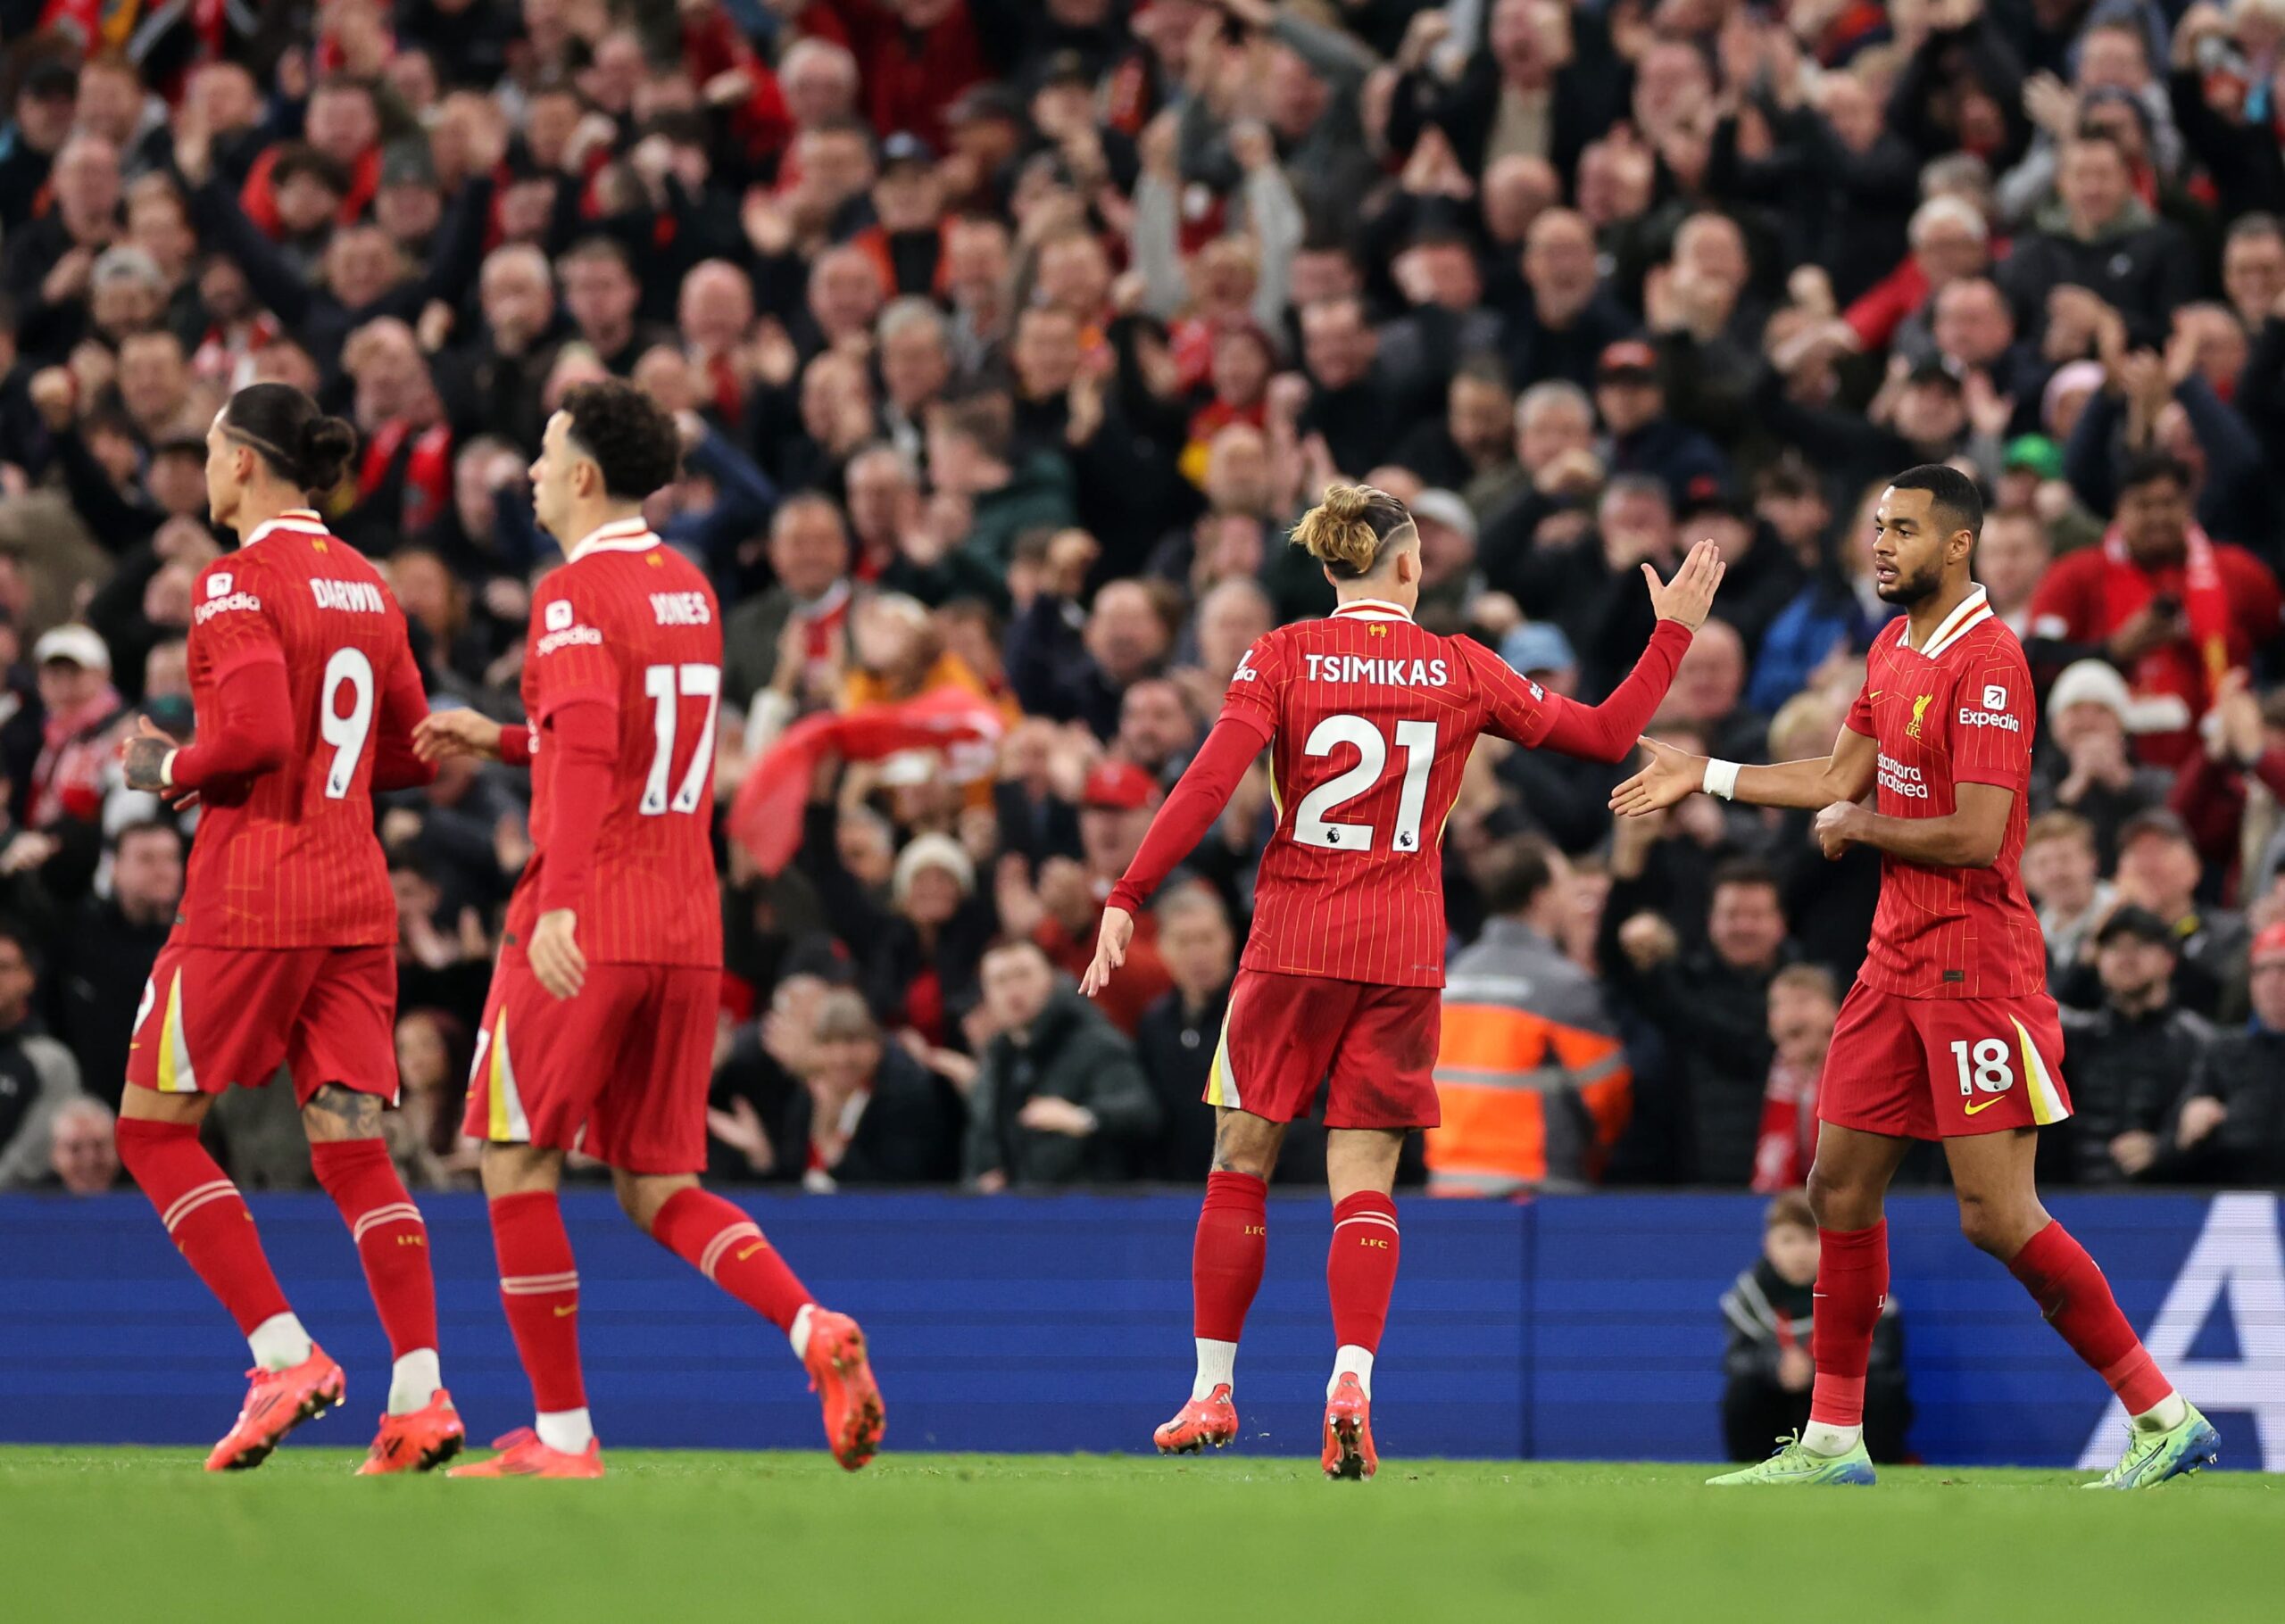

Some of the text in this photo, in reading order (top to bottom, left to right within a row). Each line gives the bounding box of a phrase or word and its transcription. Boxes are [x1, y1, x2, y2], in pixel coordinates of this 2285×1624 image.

[194, 591, 261, 626] xpedia
[309, 577, 386, 615] DARWIN
[649, 591, 711, 626] JONES
[536, 624, 602, 657] xpedia
[1305, 654, 1449, 687] TSIMIKAS
[320, 646, 375, 800] 9
[1905, 724, 1922, 740] LFC
[1959, 708, 2019, 733] Expedia
[638, 663, 721, 816] 17
[1292, 714, 1439, 852] 21
[1877, 768, 1928, 799] chatered
[1950, 1038, 2014, 1096] 18
[1244, 1225, 1266, 1236] LFC
[1360, 1238, 1389, 1249] LFC
